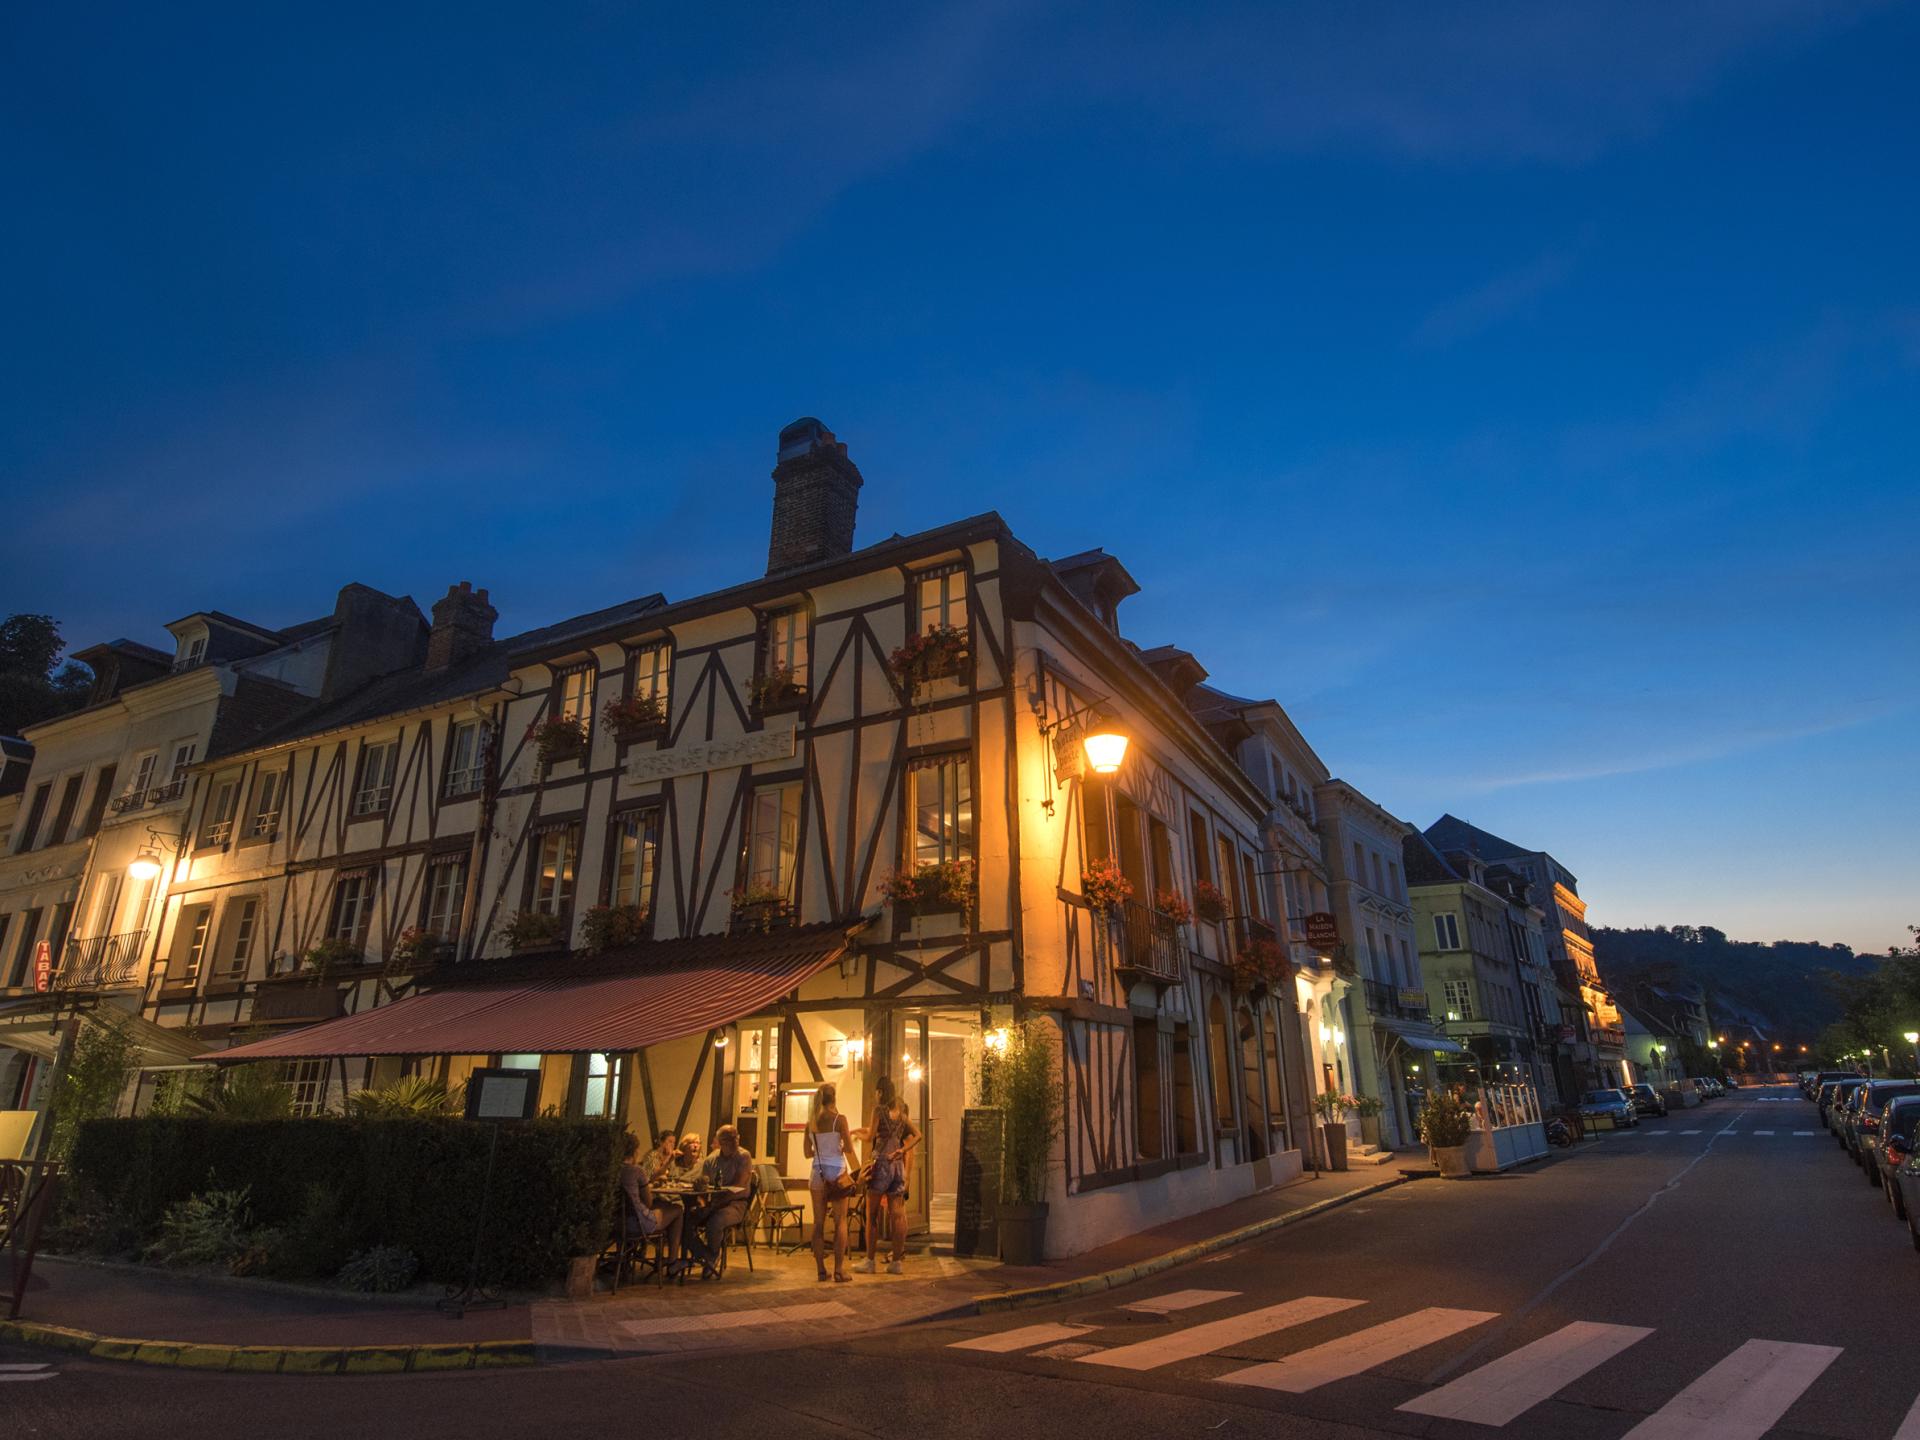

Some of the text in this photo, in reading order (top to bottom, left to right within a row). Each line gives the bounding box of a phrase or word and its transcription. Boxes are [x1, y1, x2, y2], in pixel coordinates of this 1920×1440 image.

[1315, 915, 1325, 923] LA
[1307, 931, 1337, 939] BLANCHE
[38, 943, 50, 990] TABAC
